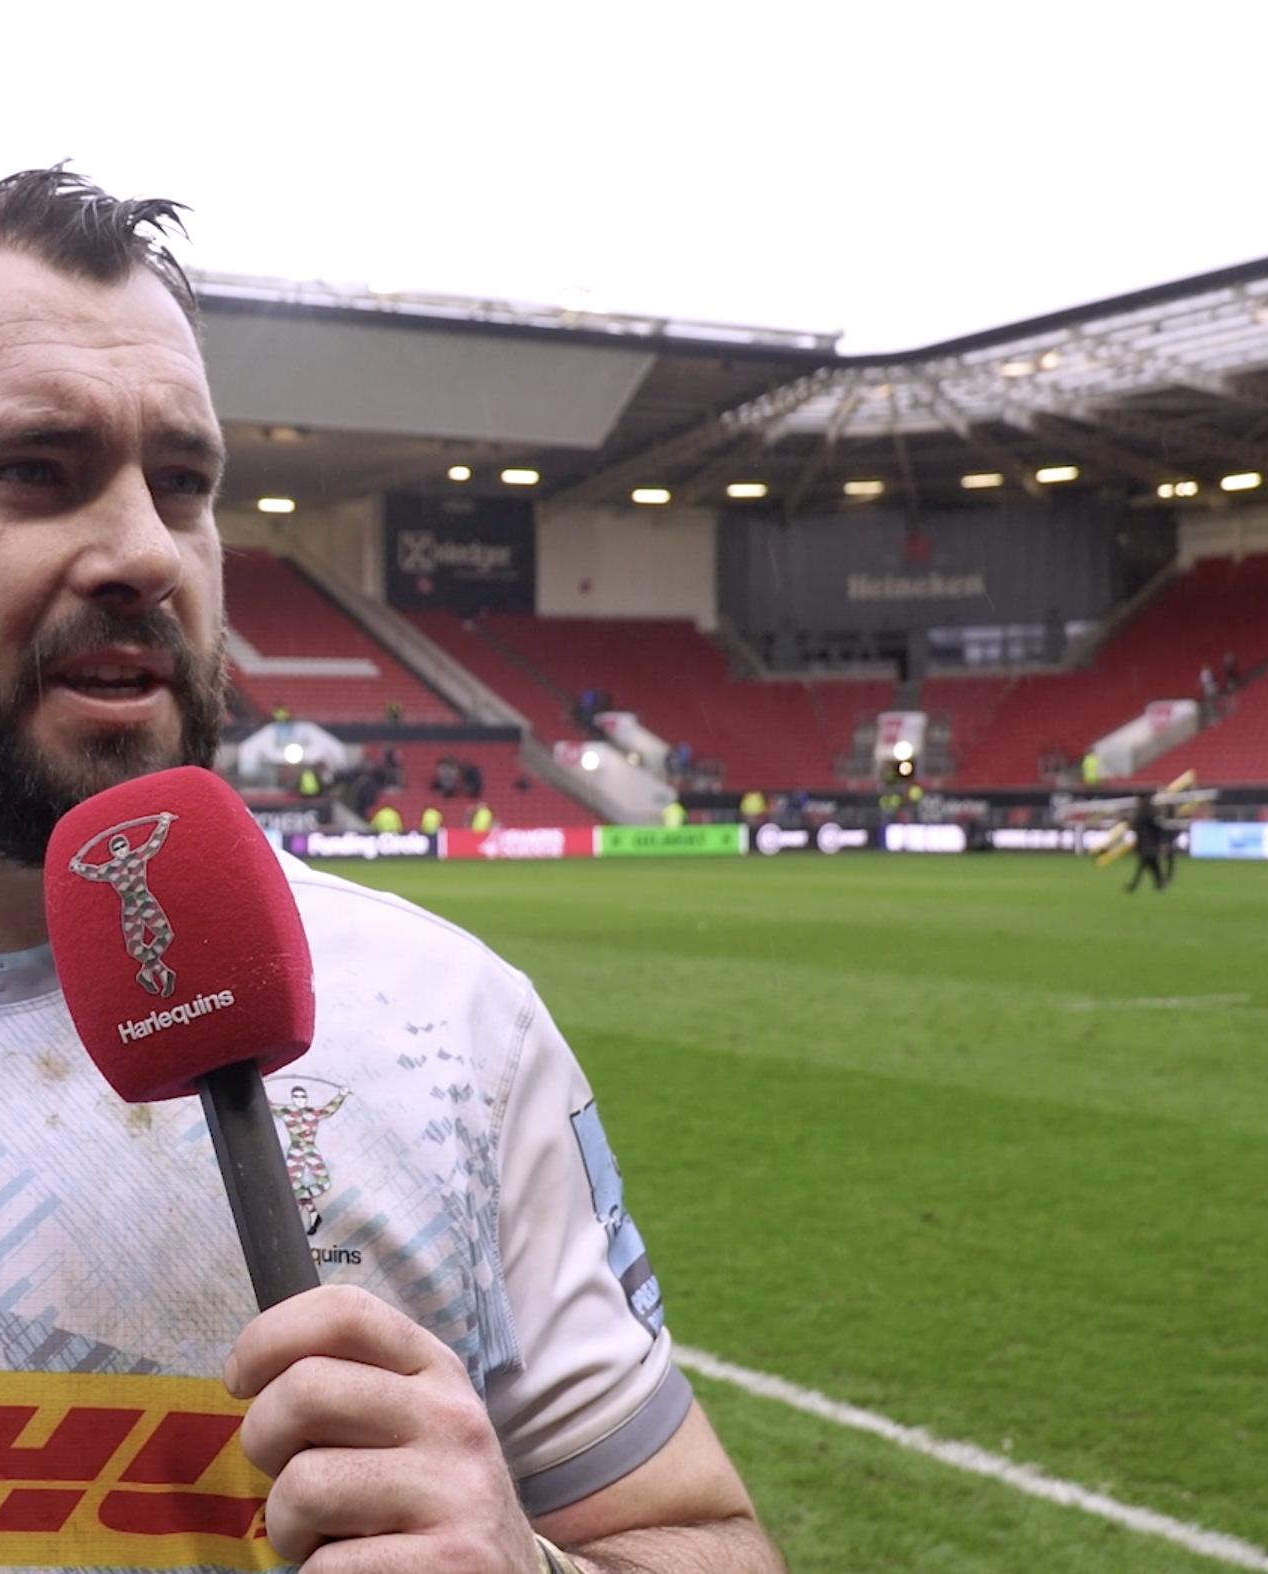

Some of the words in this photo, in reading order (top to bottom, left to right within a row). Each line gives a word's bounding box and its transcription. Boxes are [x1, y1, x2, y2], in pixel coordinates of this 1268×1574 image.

[307, 832, 378, 860] Funding
[378, 831, 430, 856] Circle
[117, 989, 235, 1044] Harlequins
[310, 1244, 362, 1267] quins
